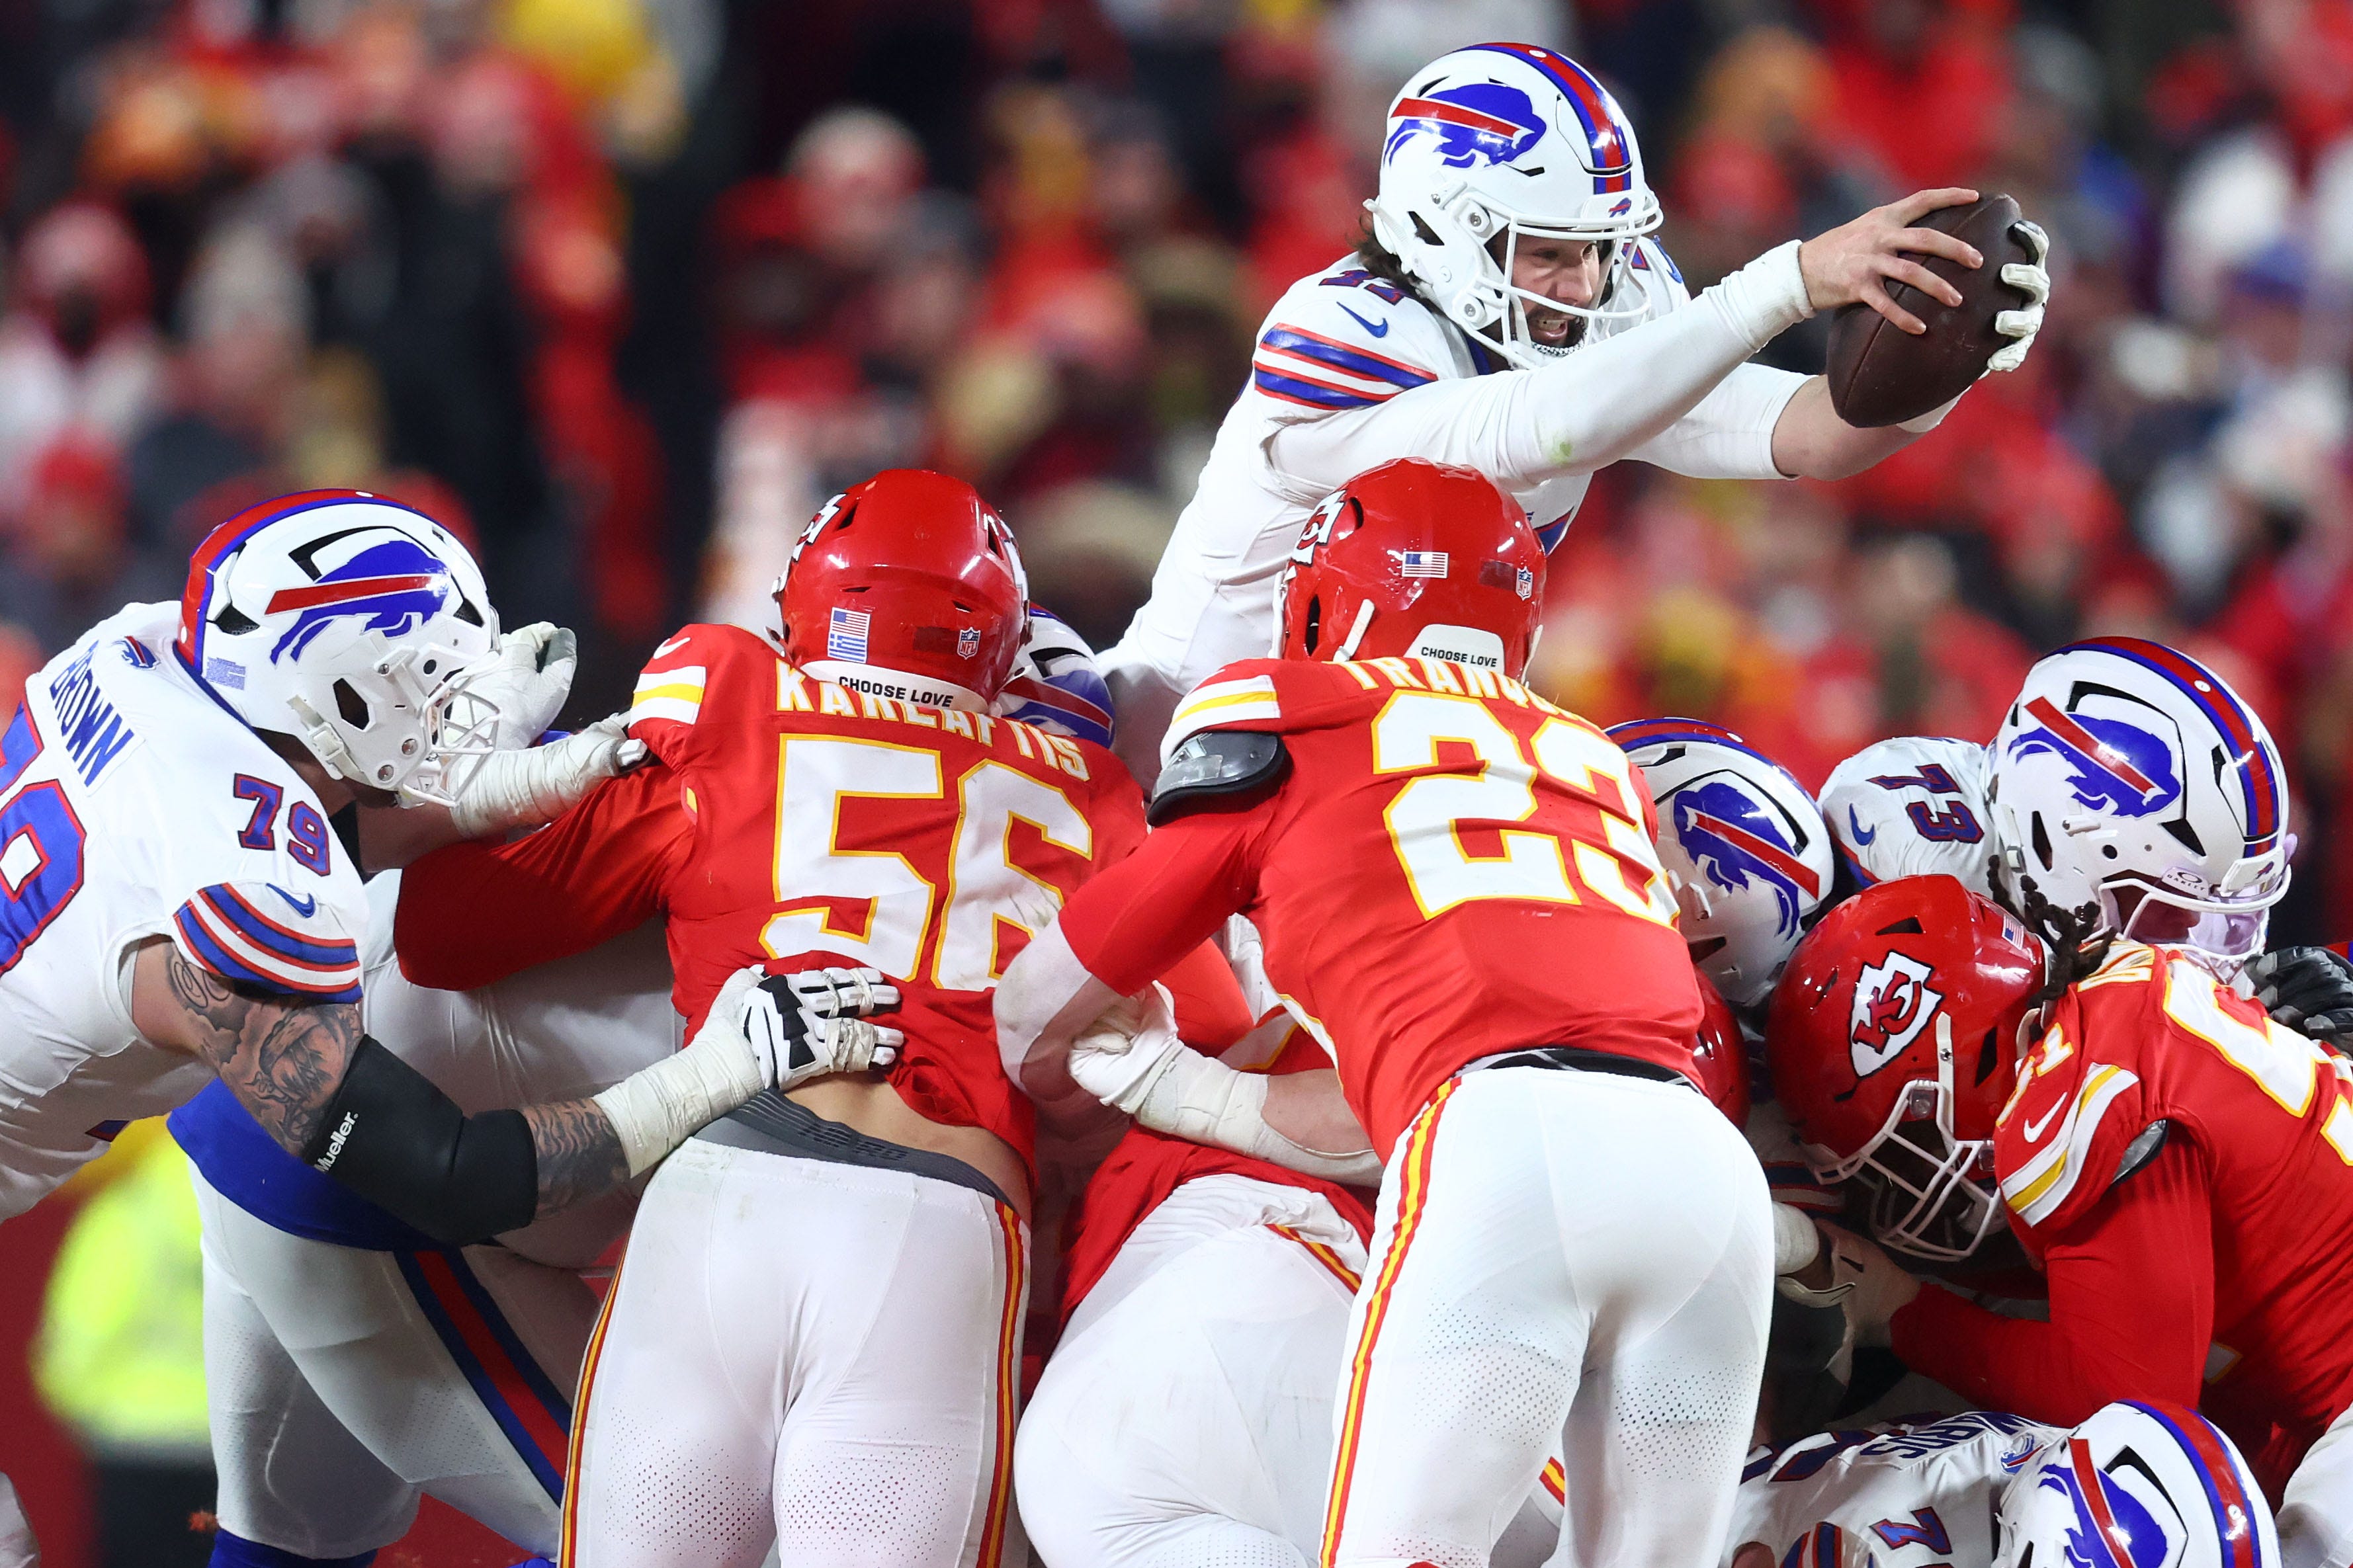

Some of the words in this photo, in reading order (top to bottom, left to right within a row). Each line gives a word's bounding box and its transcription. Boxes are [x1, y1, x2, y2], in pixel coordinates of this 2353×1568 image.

[961, 641, 977, 653] NFL
[1421, 647, 1468, 663] CHOOSE
[1470, 655, 1498, 667] LOVE
[50, 640, 134, 788] BROWN
[839, 676, 906, 700] CHOOSE
[910, 690, 954, 707] LOVE
[234, 773, 331, 877] 79
[1371, 689, 1680, 932] 23
[1865, 764, 1985, 844] 73
[759, 733, 1092, 991] 56
[1852, 970, 1922, 1055] KC
[1869, 1506, 1954, 1568] 7
